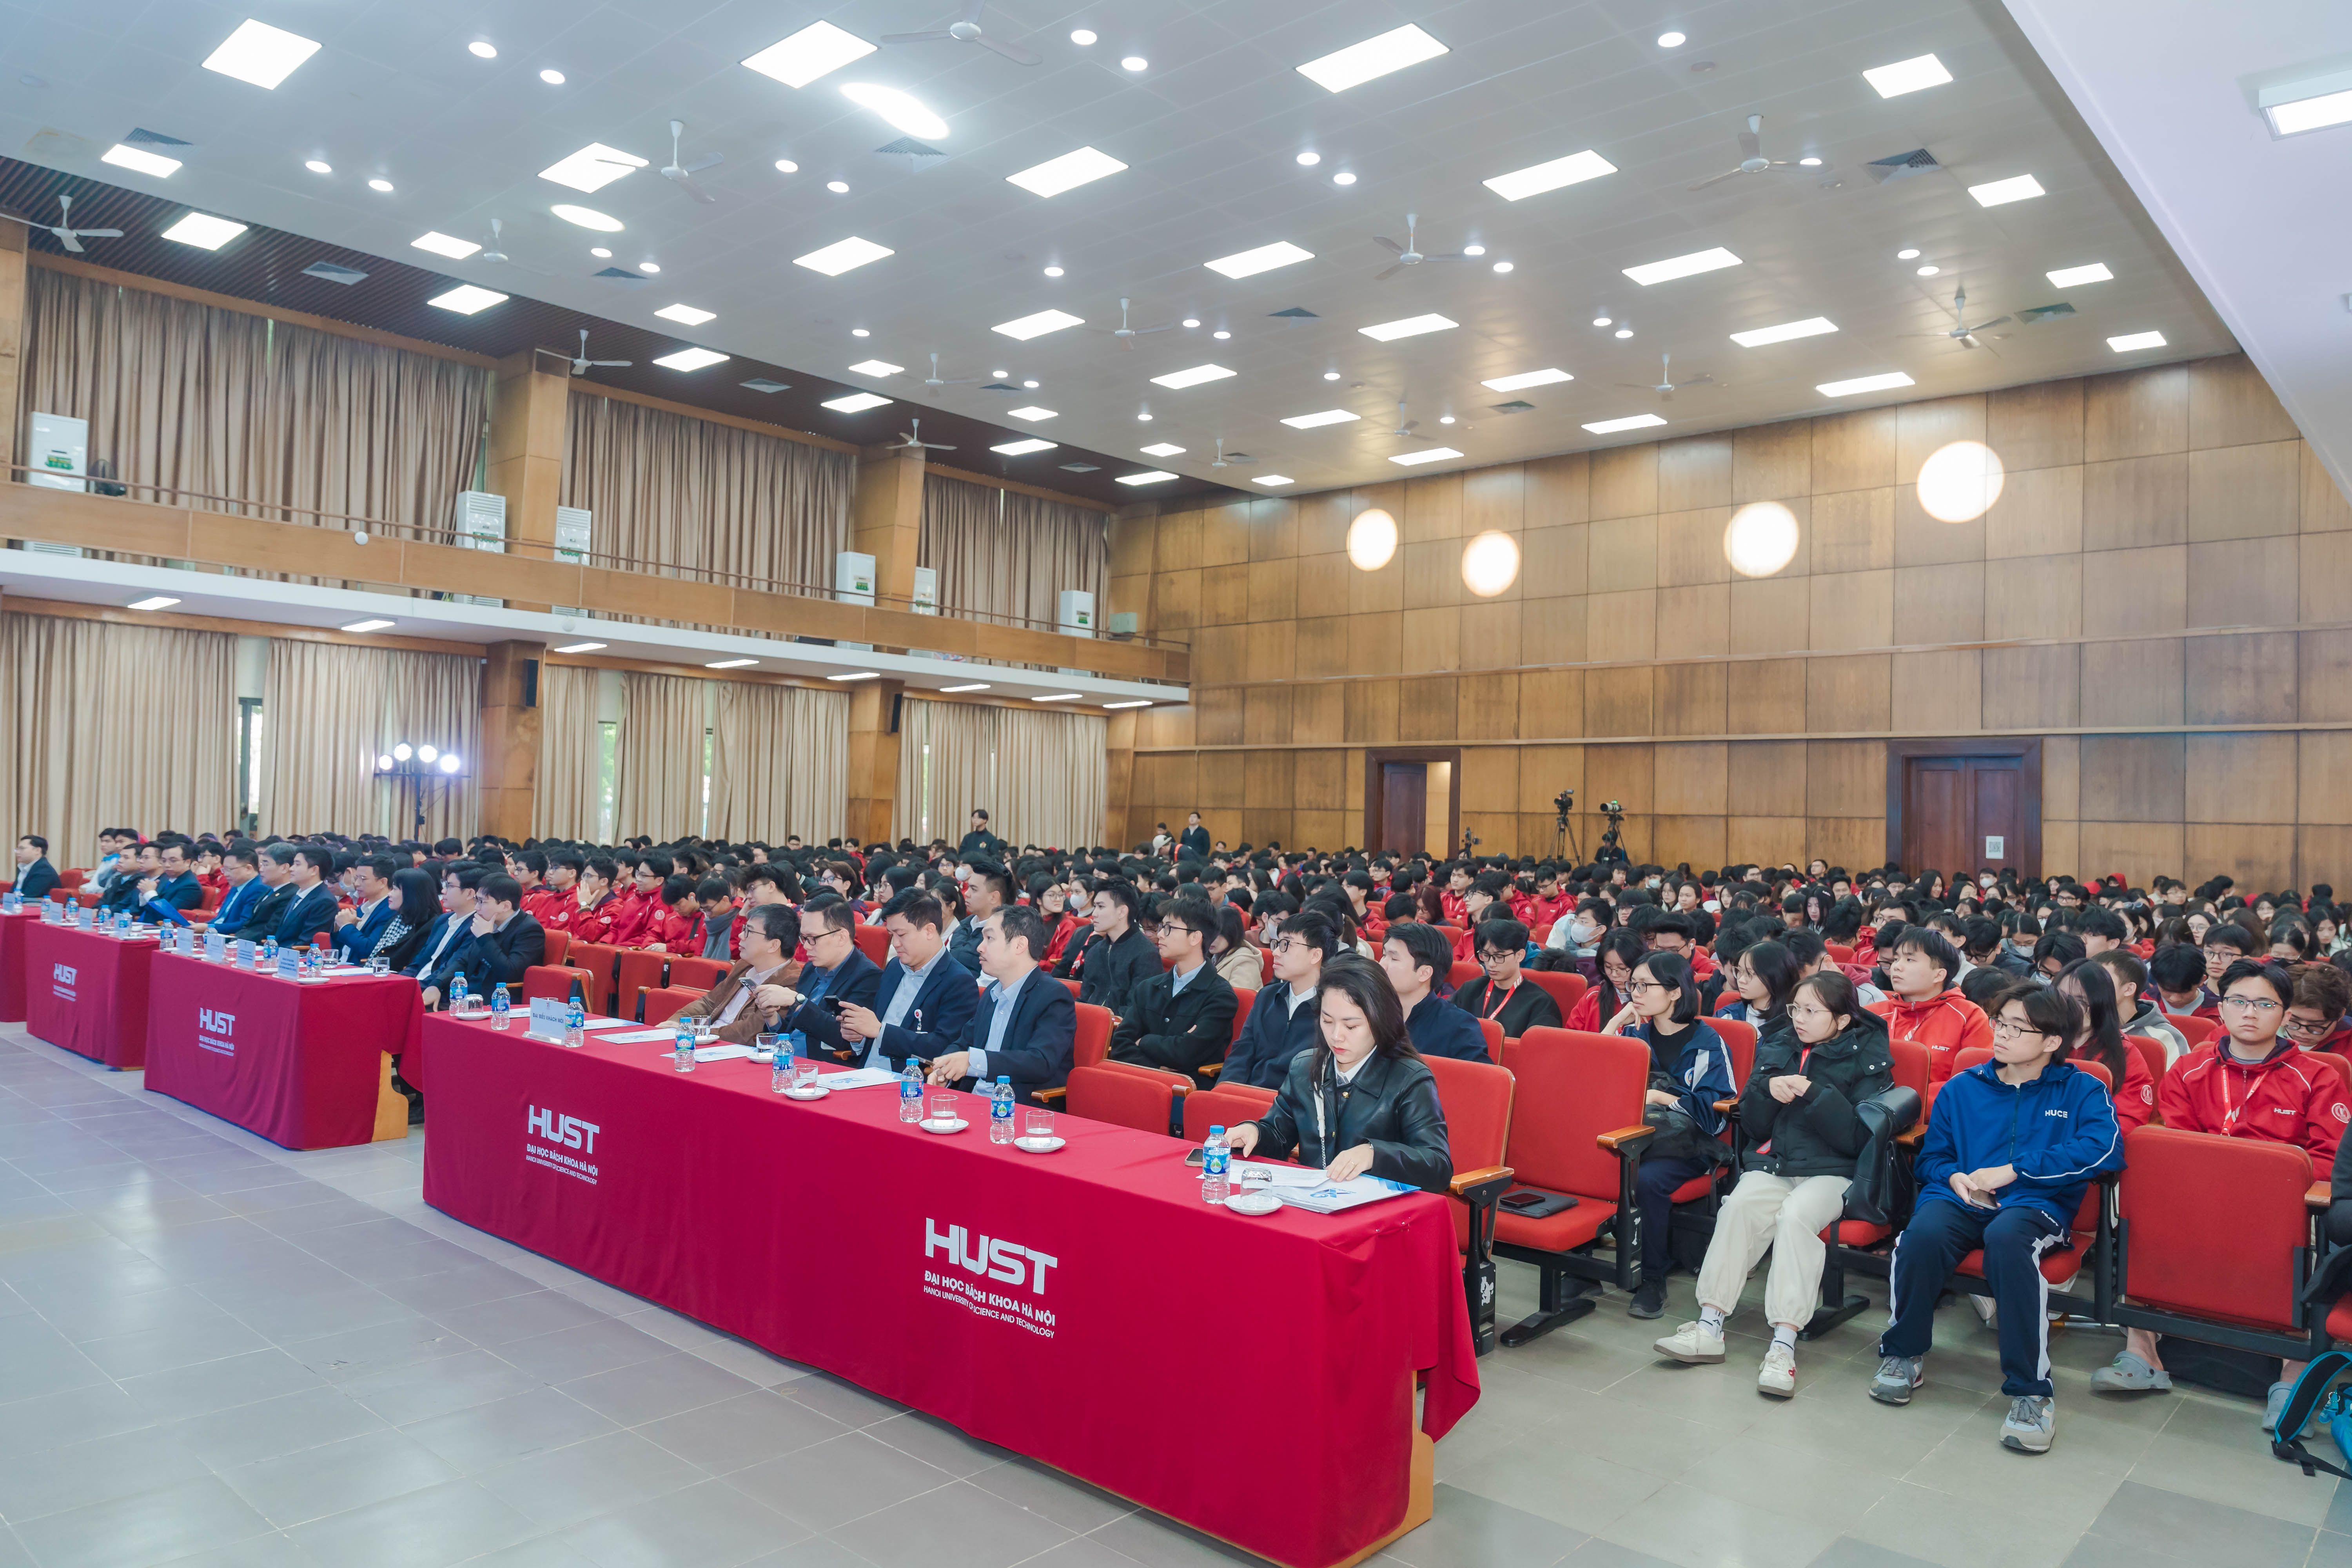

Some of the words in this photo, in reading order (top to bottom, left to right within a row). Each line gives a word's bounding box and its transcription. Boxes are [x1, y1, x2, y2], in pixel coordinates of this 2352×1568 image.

[54, 962, 77, 985] HUST
[199, 1007, 235, 1036] HUST
[528, 1104, 600, 1154] HUST
[2045, 1110, 2068, 1118] HUCE
[527, 1143, 536, 1154] ĐẠI
[537, 1146, 549, 1157] HỌC
[550, 1150, 563, 1163] BÁCH
[564, 1156, 579, 1169] KHOA
[579, 1161, 587, 1172] HÀ
[588, 1165, 598, 1176] NỘI
[537, 1159, 552, 1168] UNIVERSITY
[577, 1172, 597, 1185] TECHNOLOGY
[925, 1217, 1058, 1295] HUST
[924, 1285, 941, 1297] HANOI
[942, 1290, 969, 1307] UNIVERSITY
[969, 1301, 974, 1310] OF
[973, 1305, 999, 1319] SCIENCE
[1000, 1313, 1014, 1323] AND
[1016, 1316, 1054, 1339] TECHNOLOGY
[925, 1270, 939, 1285] ĐẠI
[942, 1276, 964, 1291] HỌC
[965, 1282, 985, 1303] BÁCH
[989, 1293, 1020, 1312] KHOA
[1022, 1303, 1033, 1319] HÀ
[1035, 1310, 1055, 1326] NỘI
